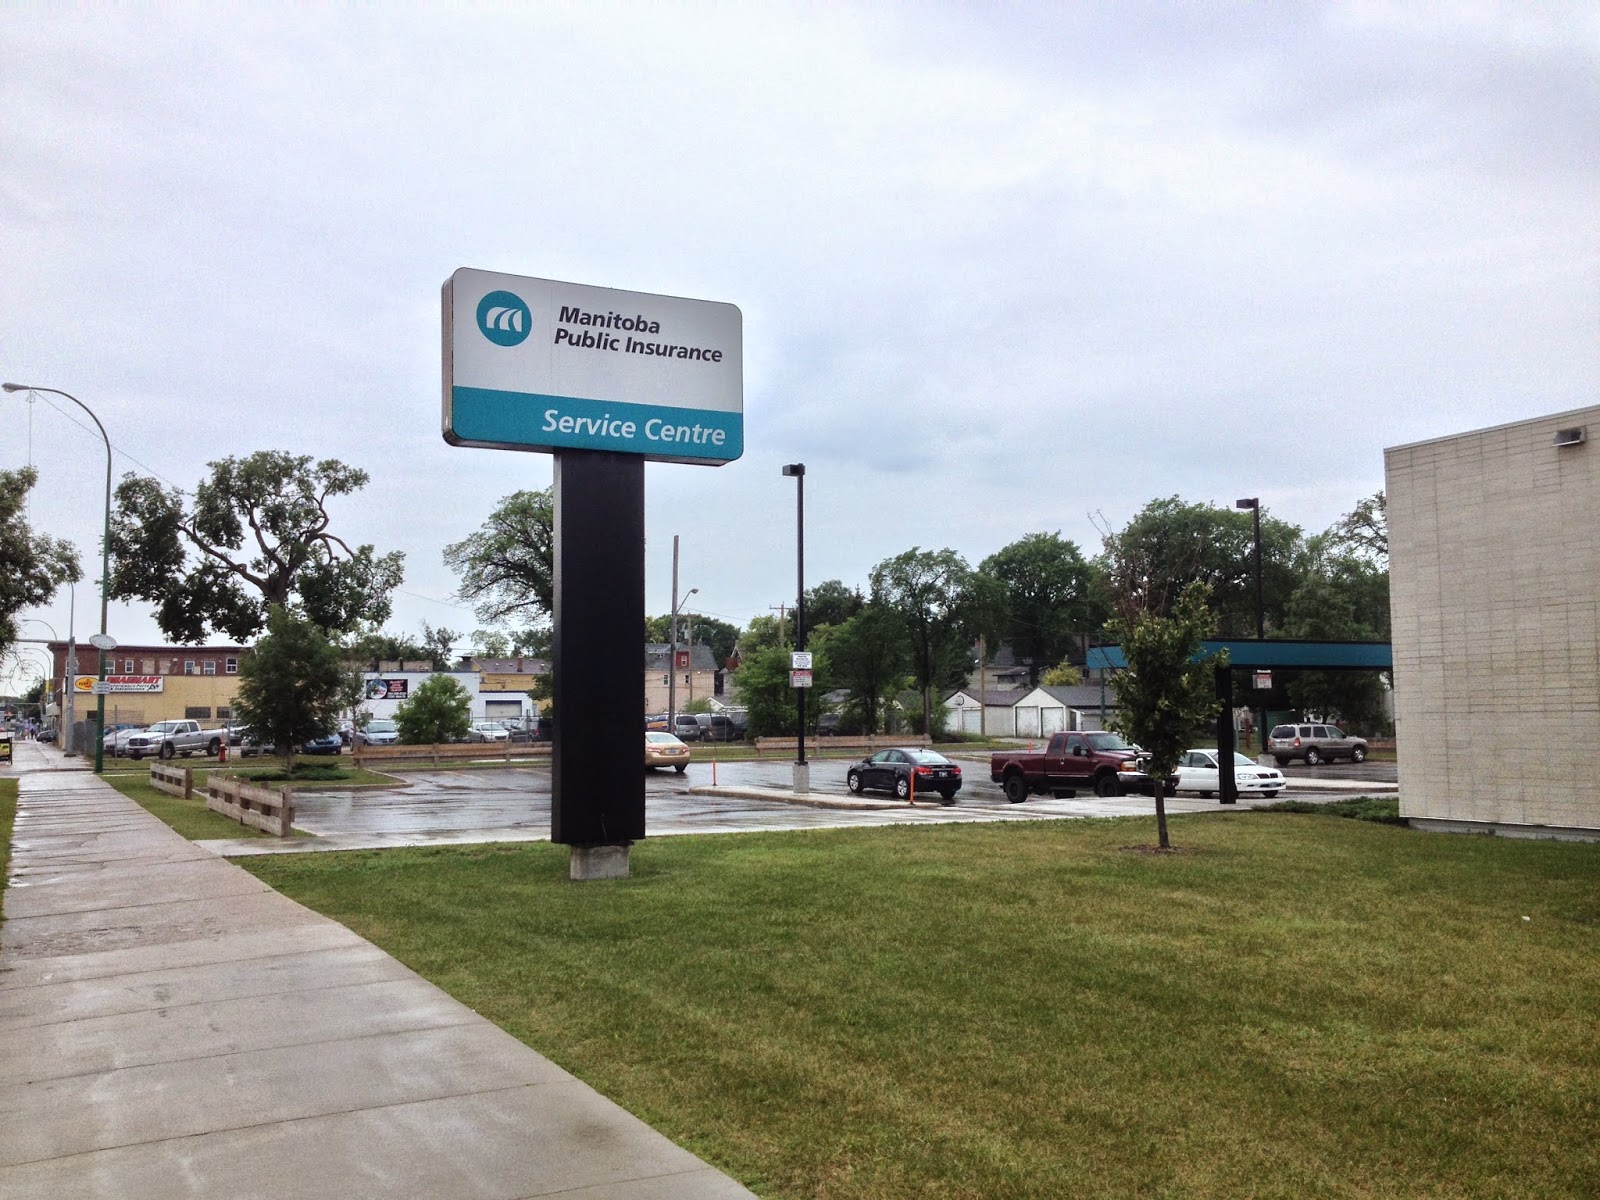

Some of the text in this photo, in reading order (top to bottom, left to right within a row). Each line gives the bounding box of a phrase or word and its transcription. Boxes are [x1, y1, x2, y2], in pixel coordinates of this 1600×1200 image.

[559, 306, 660, 334] Manitoba
[554, 328, 723, 362] Public Insurance
[542, 409, 726, 445] Service Centre
